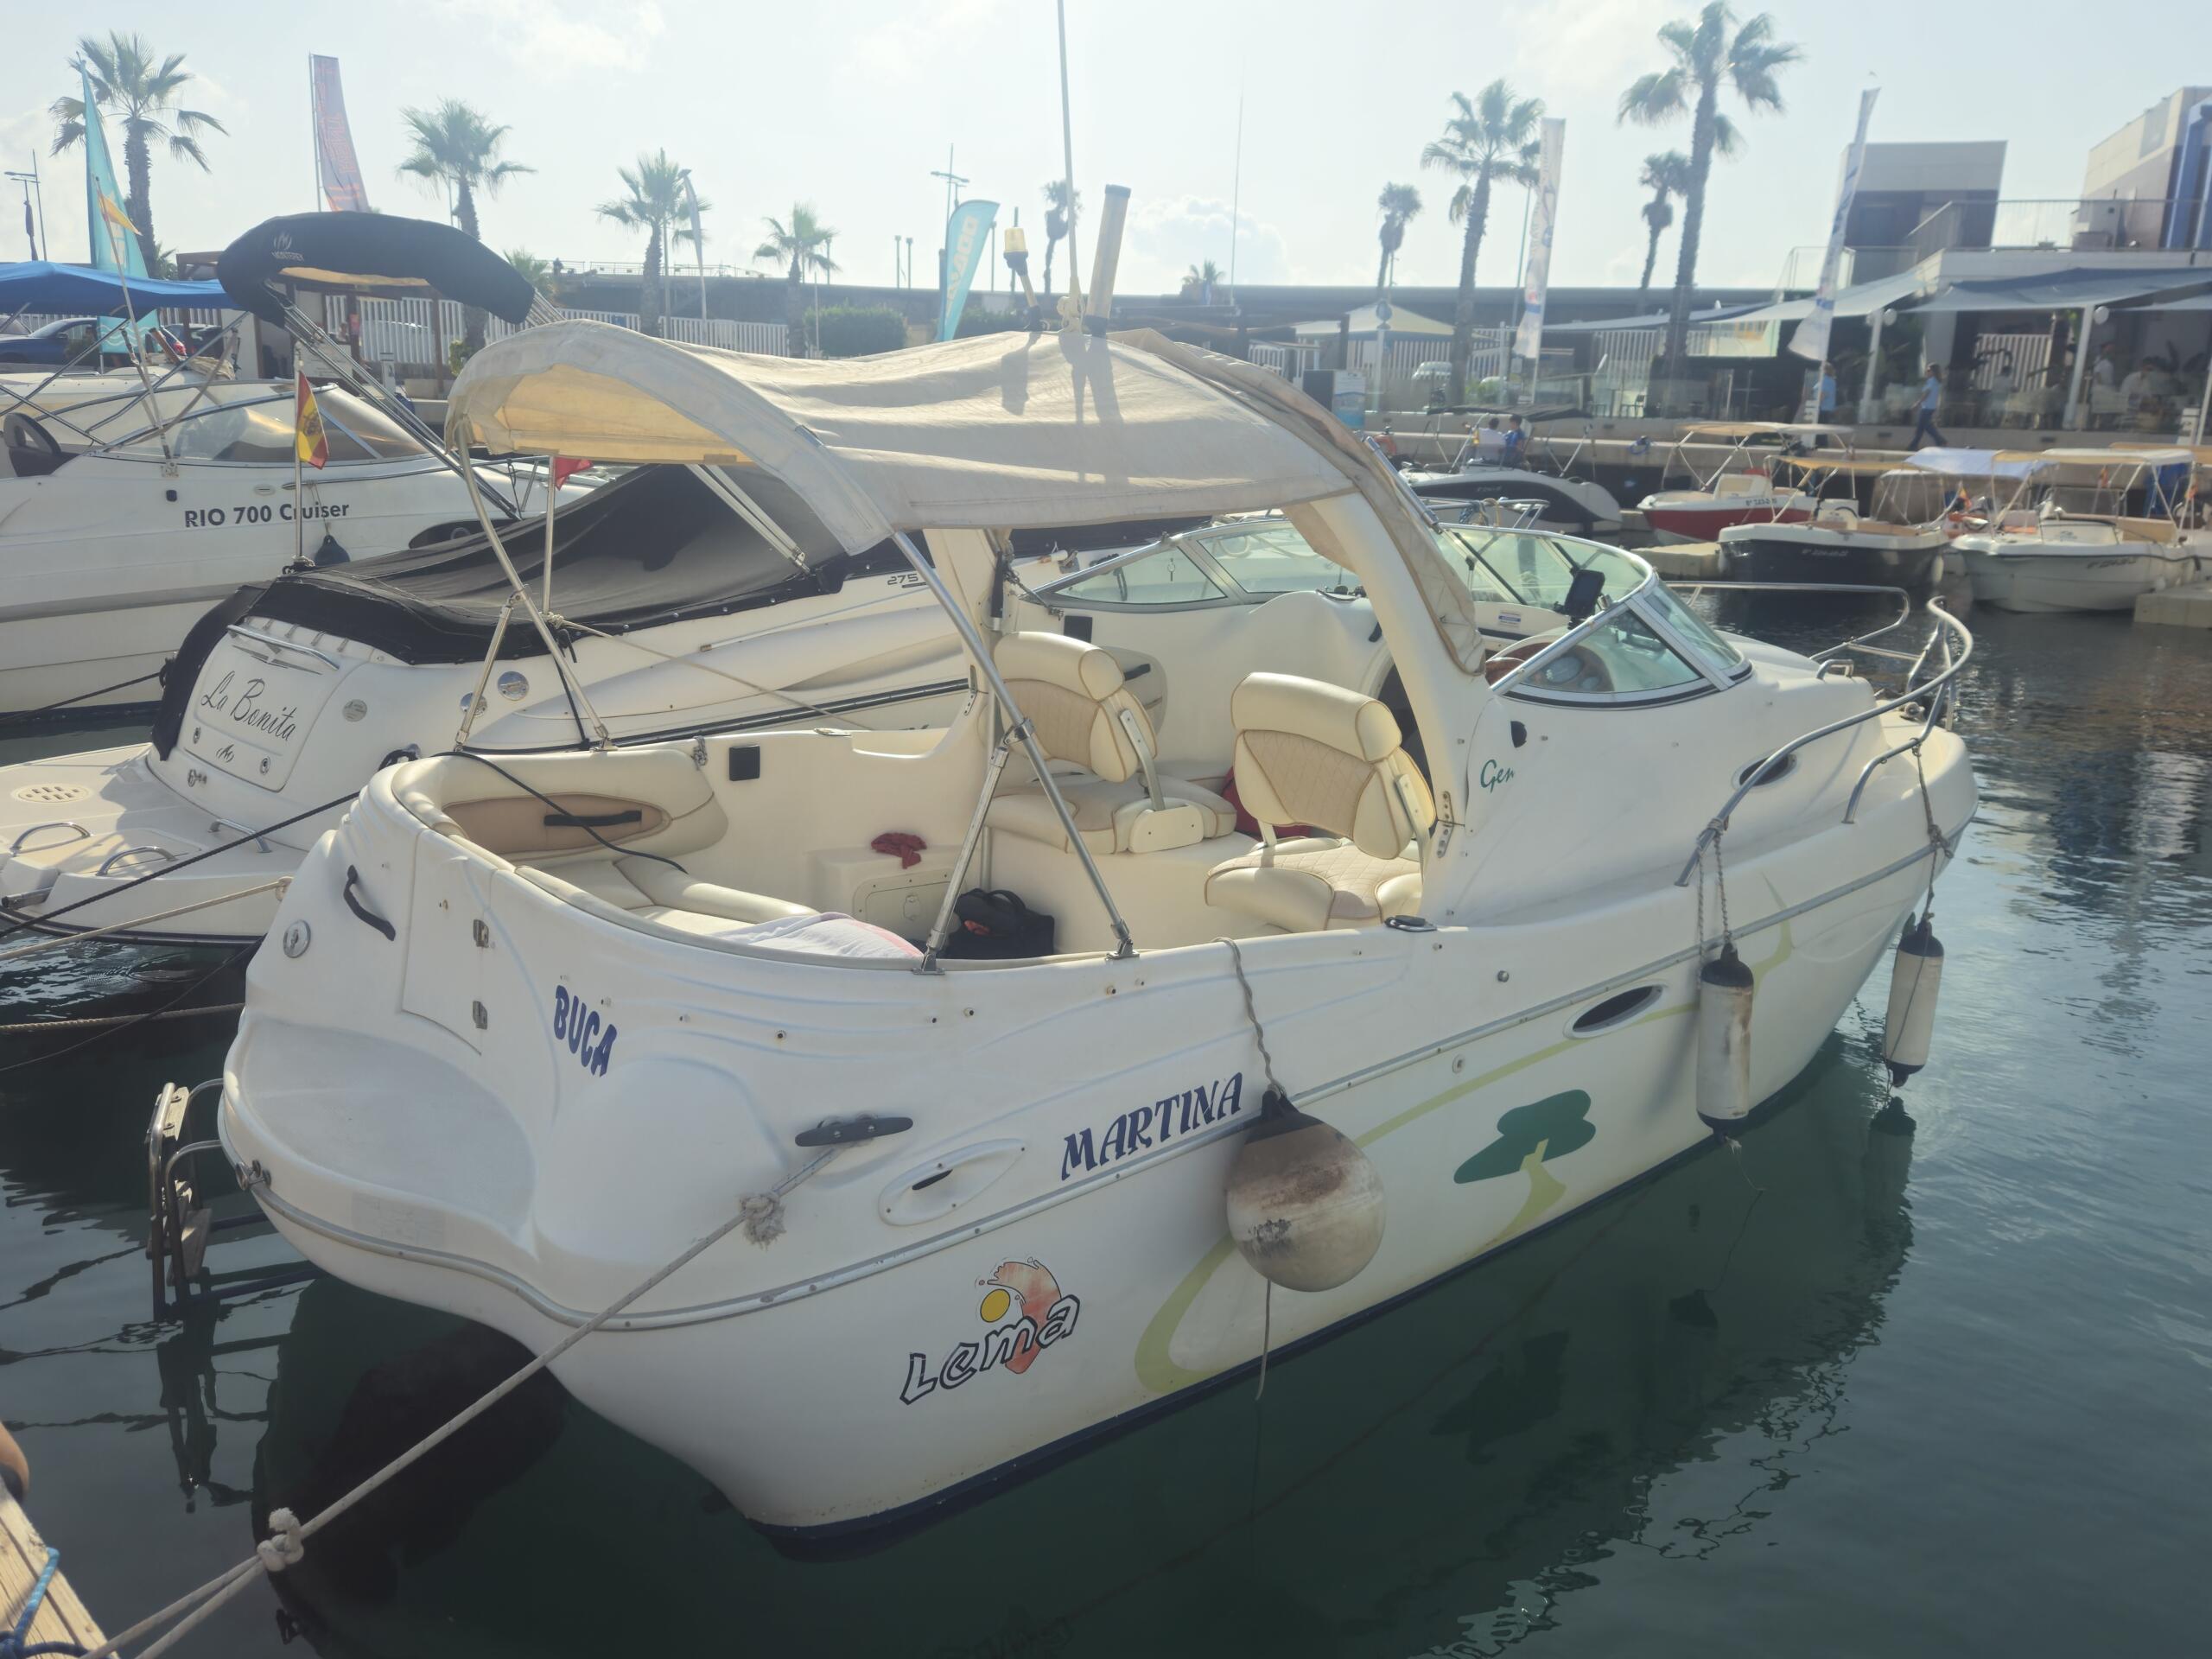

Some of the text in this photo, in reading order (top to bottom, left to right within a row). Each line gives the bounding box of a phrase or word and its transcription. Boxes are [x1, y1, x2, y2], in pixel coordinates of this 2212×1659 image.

[184, 508, 226, 528] RIO
[233, 505, 272, 524] 700
[887, 573, 918, 586] 275
[200, 671, 235, 712] La
[230, 678, 297, 741] Bonita
[554, 985, 617, 1077] BUCA
[1061, 1072, 1243, 1181] MARTINA
[899, 1294, 1080, 1405] Lema
